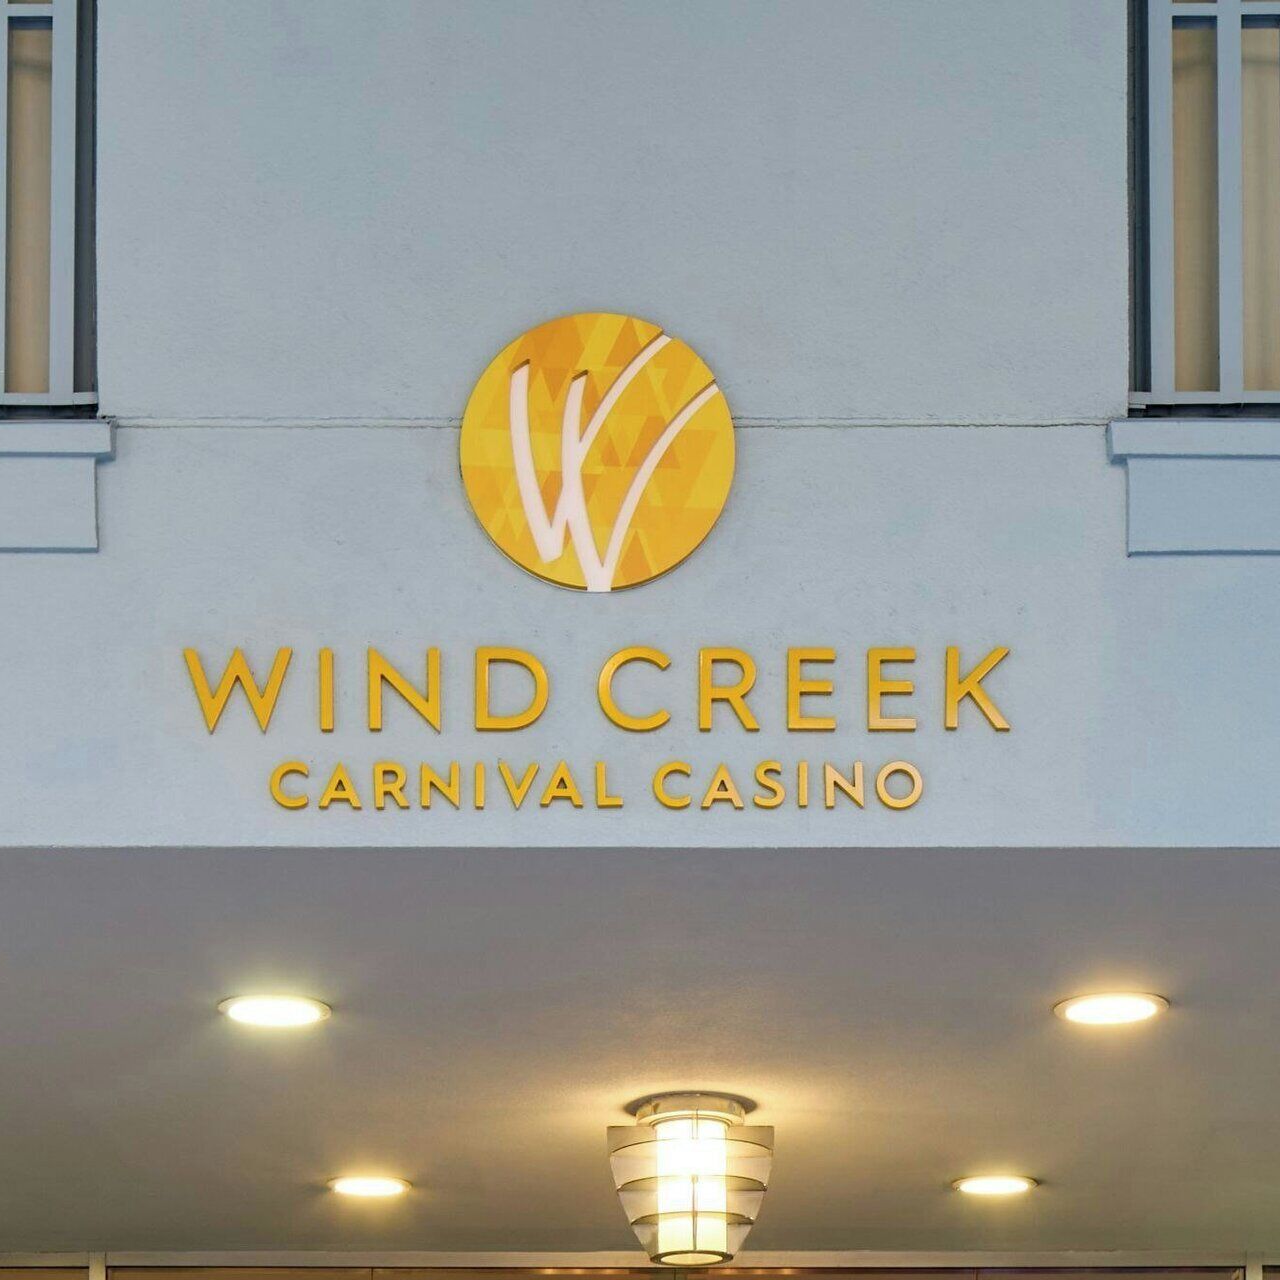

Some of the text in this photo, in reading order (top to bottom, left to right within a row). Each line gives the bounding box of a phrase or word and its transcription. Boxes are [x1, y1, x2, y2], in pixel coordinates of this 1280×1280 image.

[182, 645, 1010, 734] WIND CREEK
[268, 759, 925, 811] CARNIVAL CASINO
